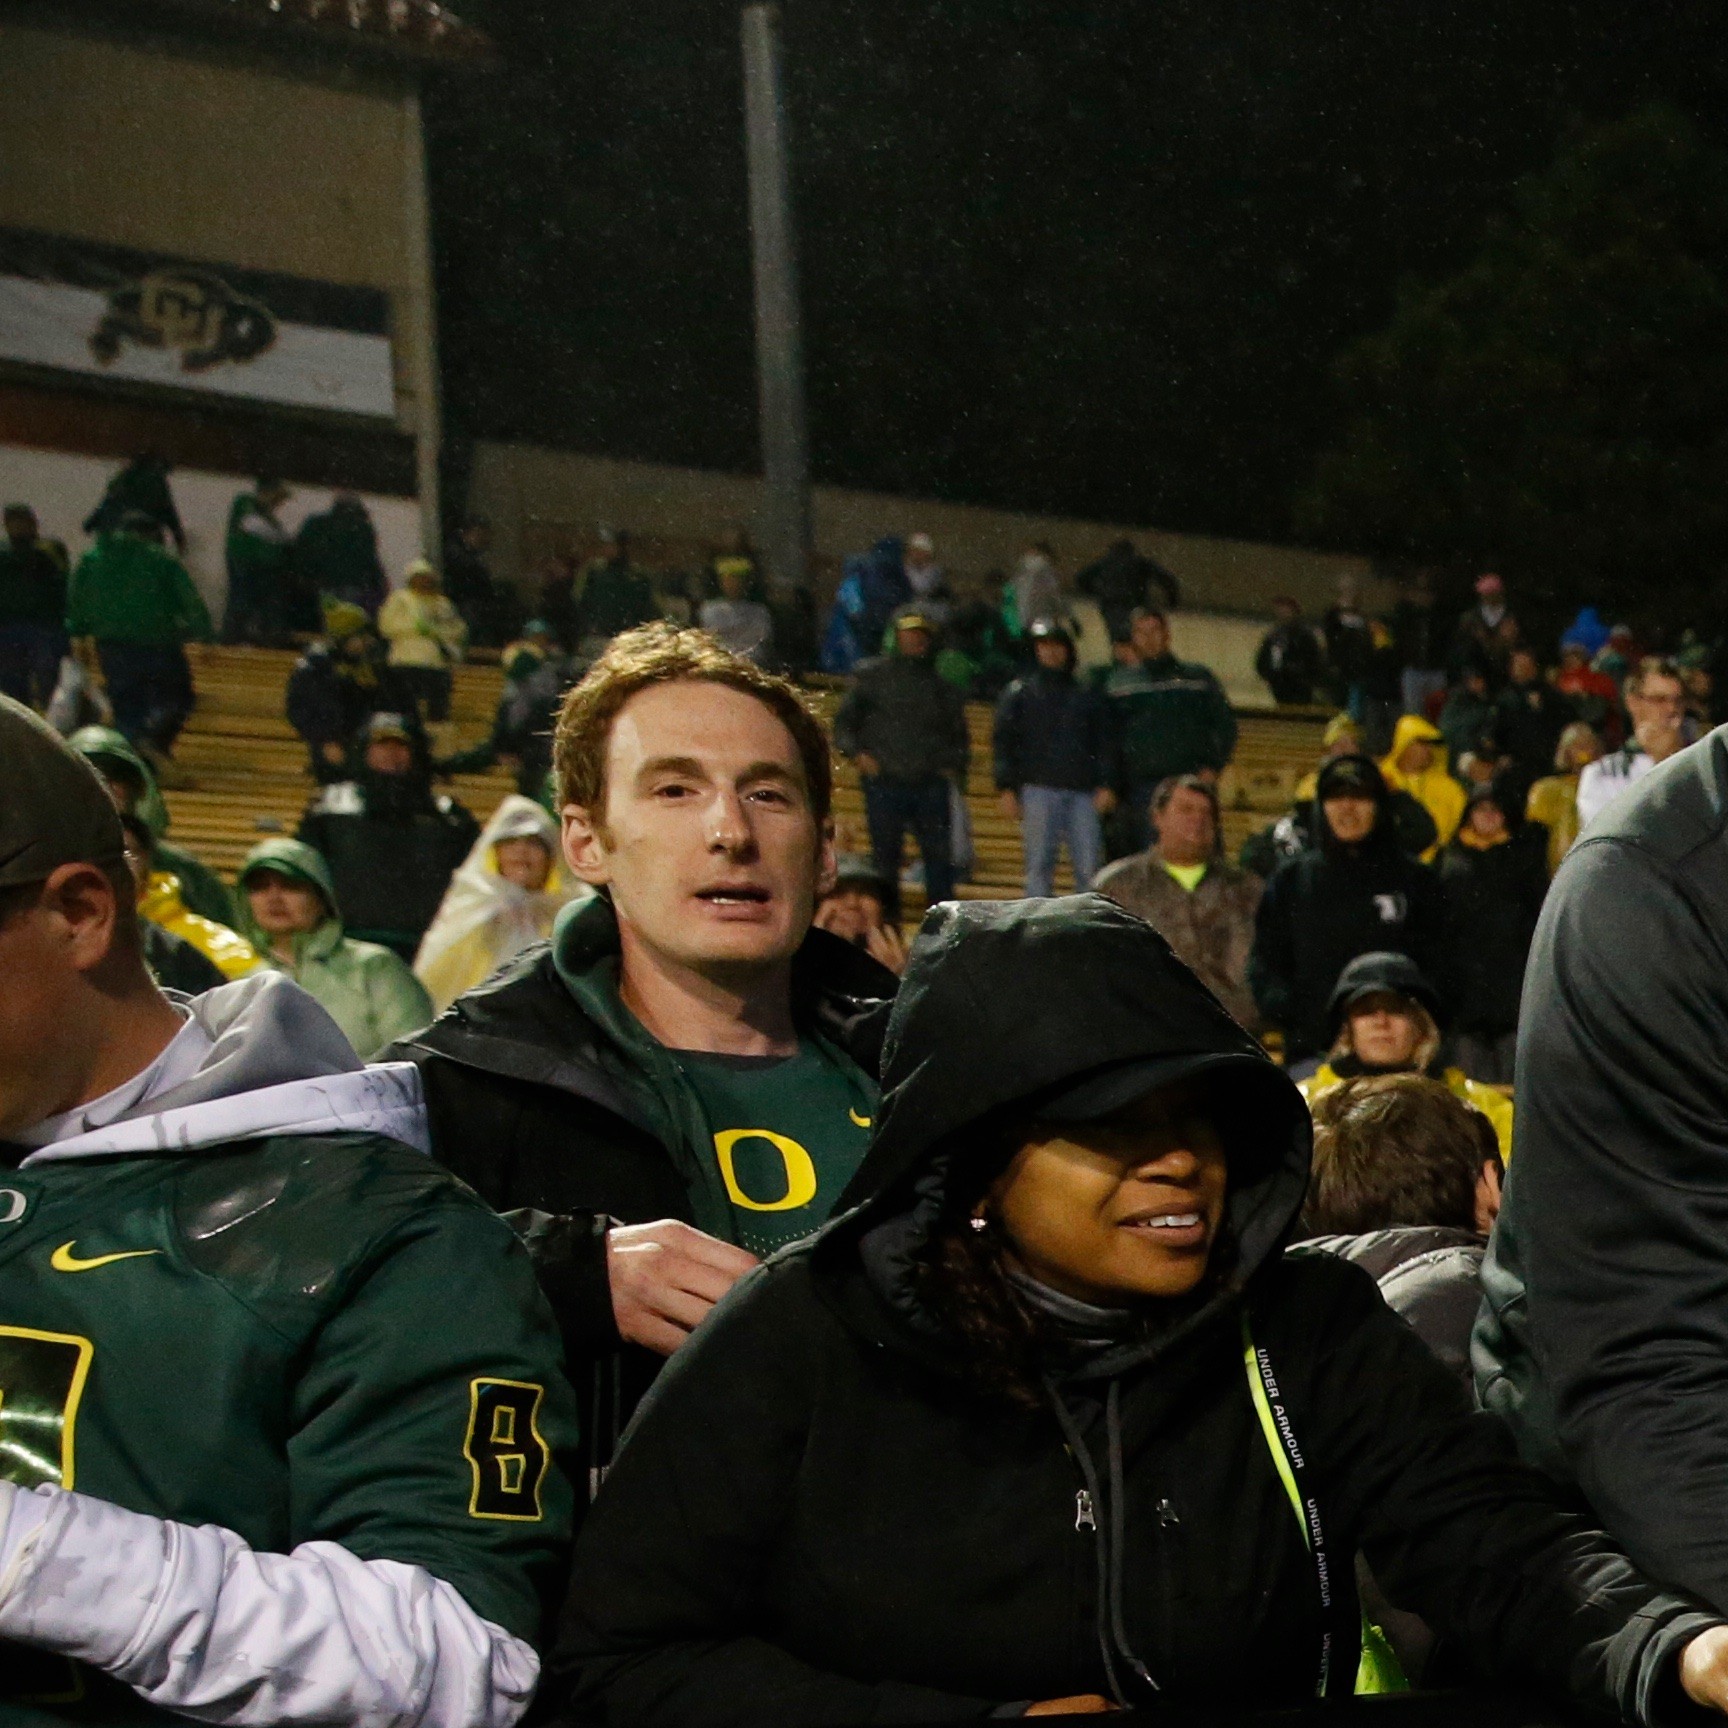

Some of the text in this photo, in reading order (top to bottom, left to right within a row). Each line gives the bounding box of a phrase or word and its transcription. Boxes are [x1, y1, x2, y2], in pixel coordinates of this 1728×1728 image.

[713, 1128, 817, 1211] O
[463, 1376, 550, 1523] 8
[1257, 1348, 1305, 1469] UNDER ARMOUR
[1306, 1498, 1331, 1608] UNDER ARMOUR
